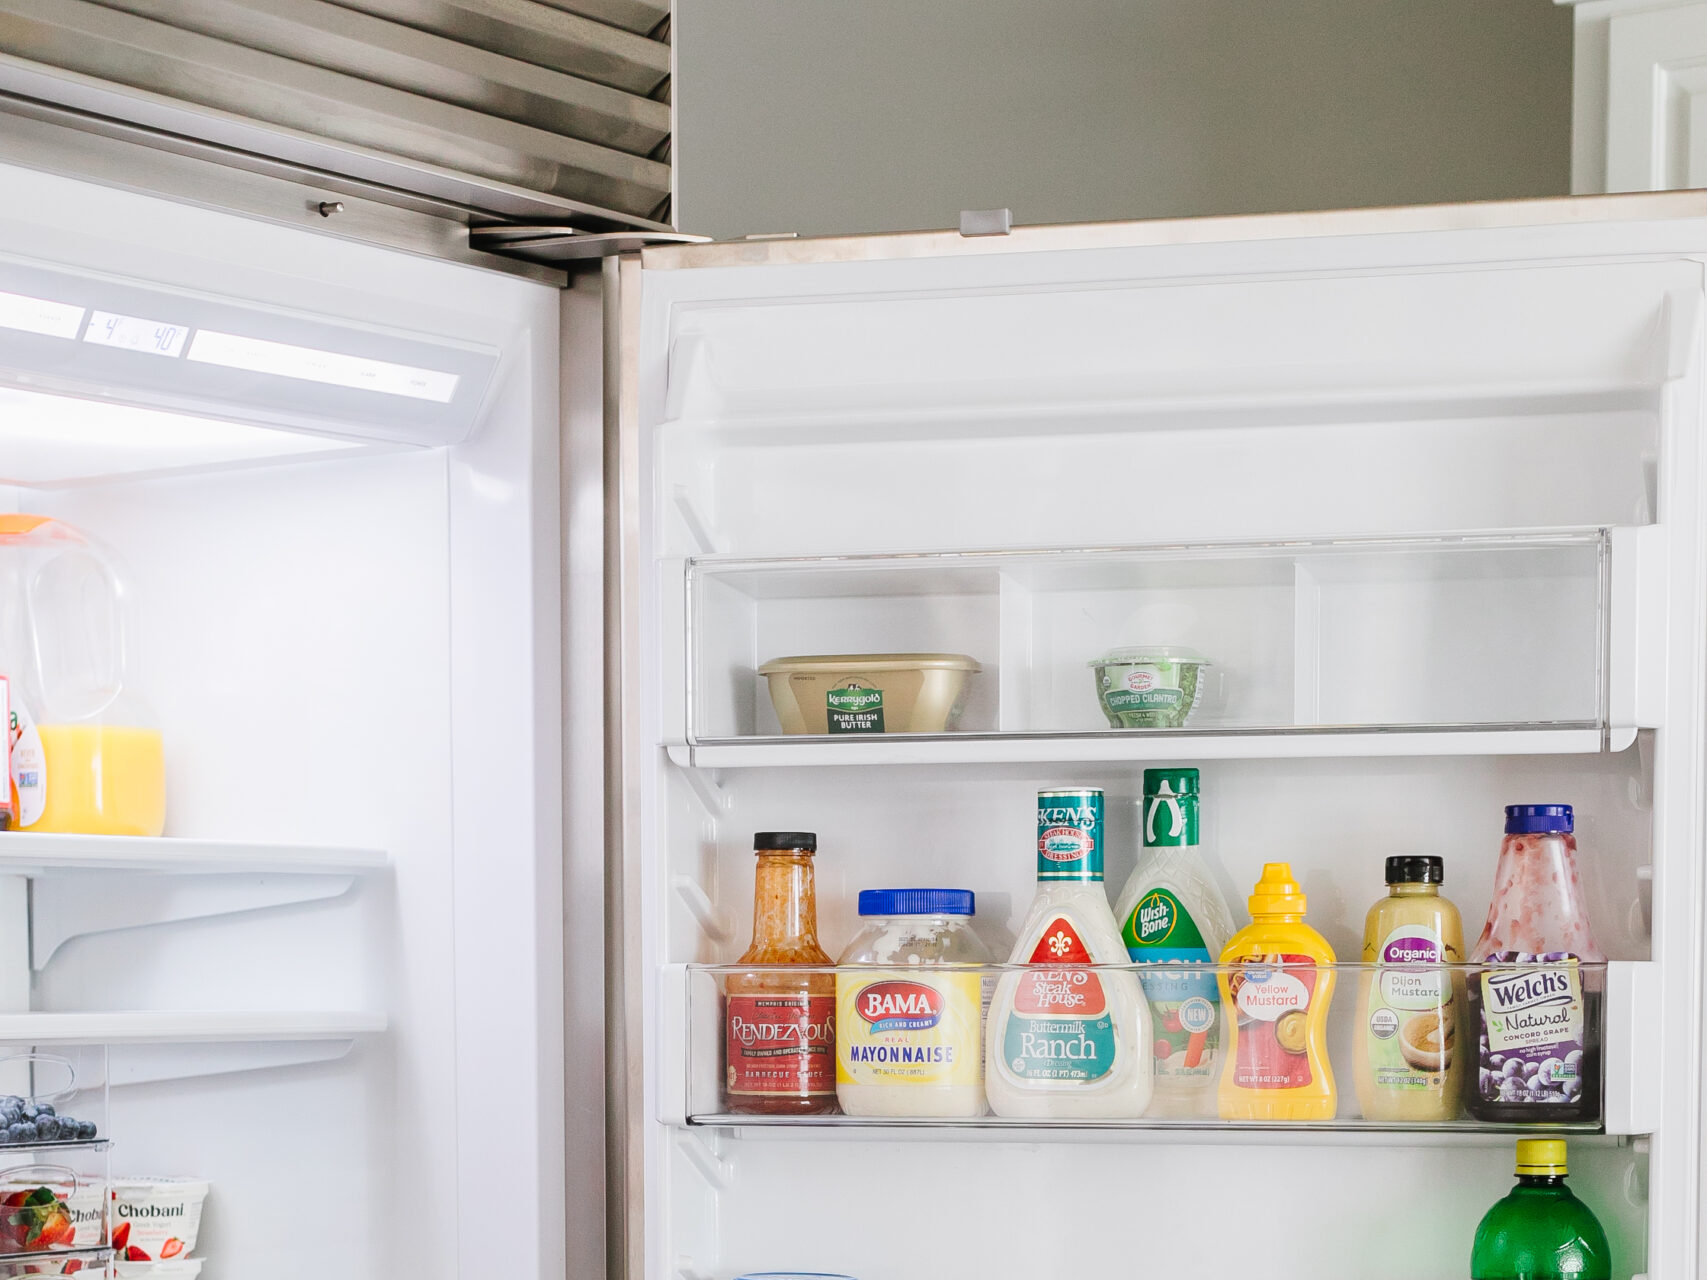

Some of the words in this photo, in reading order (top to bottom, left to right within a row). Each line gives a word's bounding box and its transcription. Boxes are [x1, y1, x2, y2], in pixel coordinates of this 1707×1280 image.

[829, 693, 881, 706] Kerrygold
[1110, 694, 1140, 706] CHOPPED
[1142, 694, 1178, 704] CILANTRO
[834, 714, 854, 722] PURE
[856, 713, 878, 722] IRISH
[841, 721, 872, 729] BUTTER
[1038, 807, 1097, 830] KEN'S
[1140, 902, 1169, 924] Wish-
[1141, 917, 1169, 938] Bone
[1389, 947, 1437, 961] Organic
[1033, 982, 1072, 995] Steak
[1142, 981, 1189, 991] ESSING
[1392, 976, 1422, 987] Dijon
[1255, 985, 1289, 994] Yellow
[1493, 972, 1568, 1008] Welch's
[865, 994, 933, 1017] BAMA
[1037, 993, 1084, 1008] House
[1246, 995, 1298, 1006] Mustard
[1187, 1008, 1206, 1021] NEW
[1376, 1015, 1393, 1023] USDA
[1506, 1007, 1570, 1031] Natural
[895, 1020, 907, 1028] AND
[909, 1019, 933, 1028] CREAMY
[1029, 1020, 1086, 1034] Buttermilk
[1504, 1032, 1541, 1041] CONCORD
[1543, 1026, 1570, 1036] GRAPE
[1525, 1036, 1549, 1044] SPREAD
[1020, 1032, 1098, 1060] Ranch
[851, 1046, 953, 1063] MAYONNAISE
[71, 1208, 102, 1223] Chob
[118, 1202, 184, 1218] Chobani
